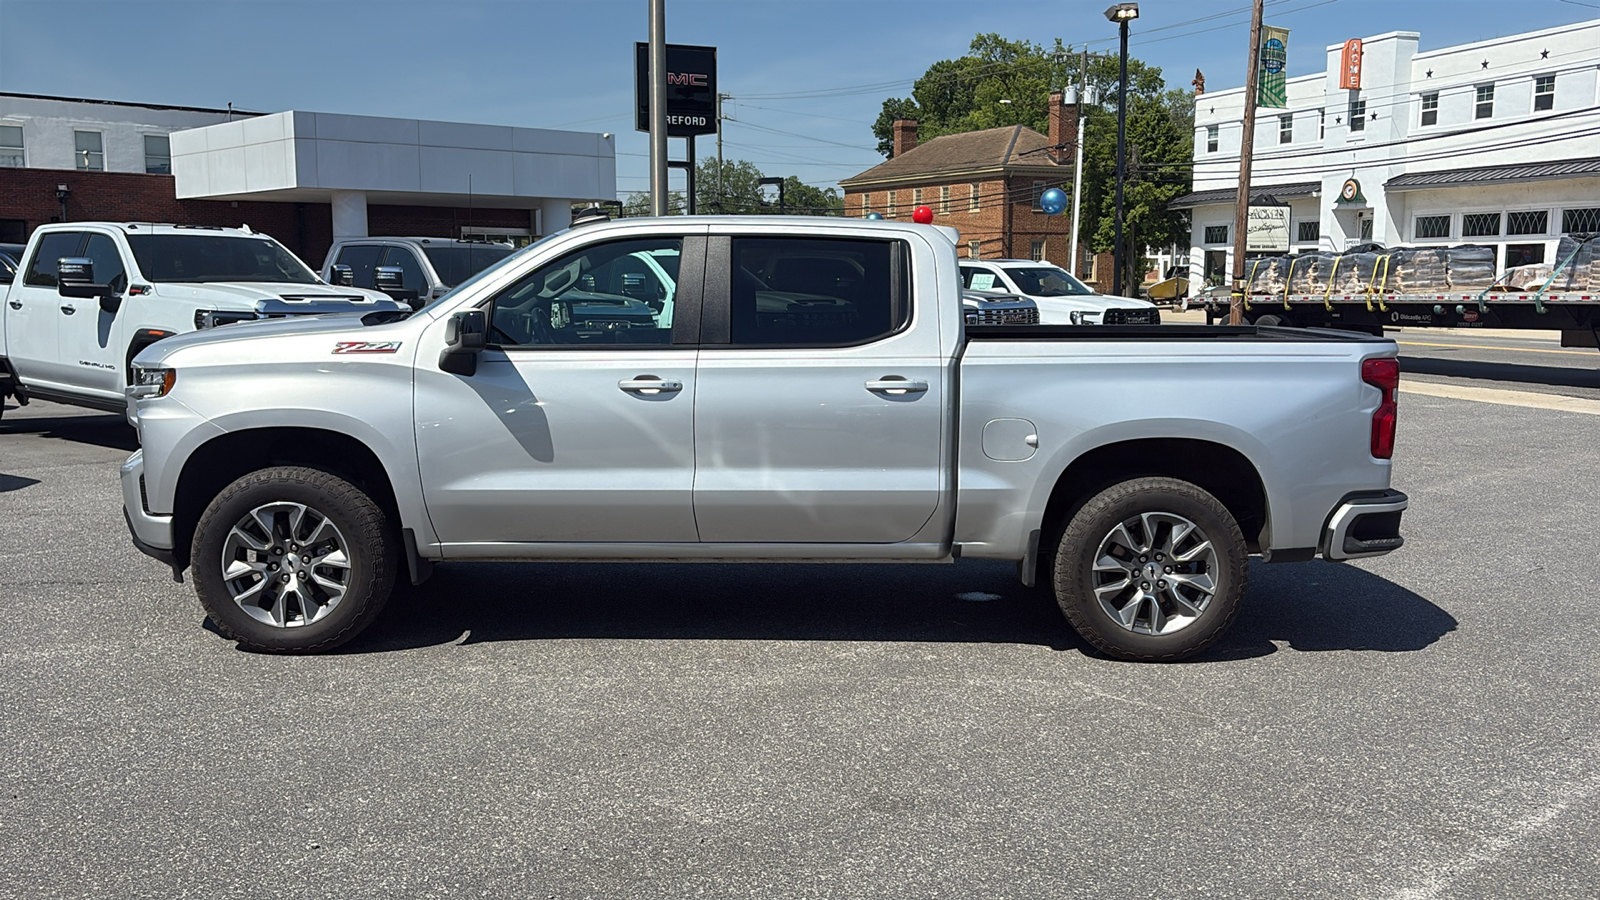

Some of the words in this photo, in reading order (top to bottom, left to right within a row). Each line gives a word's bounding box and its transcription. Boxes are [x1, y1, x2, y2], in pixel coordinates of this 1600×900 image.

[1350, 42, 1359, 86] ACME
[667, 72, 708, 86] MC
[666, 115, 707, 126] REFORD
[331, 341, 403, 354] Z71
[79, 360, 105, 368] DENALI
